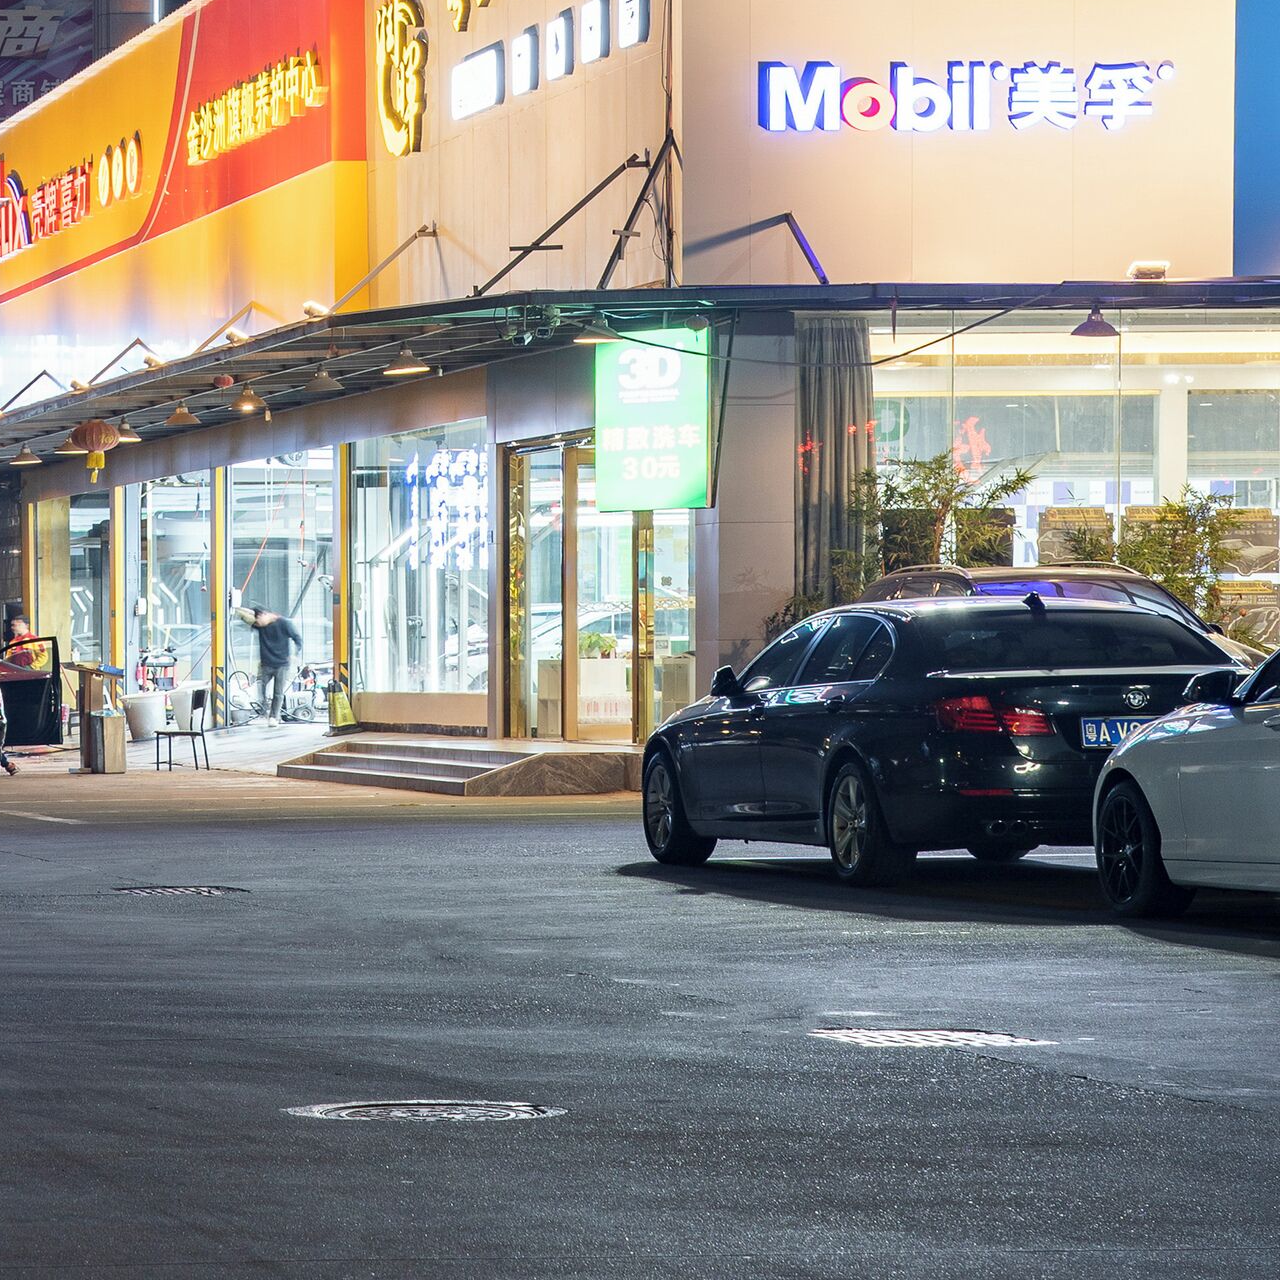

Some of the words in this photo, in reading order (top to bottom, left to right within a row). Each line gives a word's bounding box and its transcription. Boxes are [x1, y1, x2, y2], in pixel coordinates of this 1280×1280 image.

[759, 61, 991, 132] Mobil
[1008, 60, 1155, 132] 美孚
[622, 455, 681, 480] 30元
